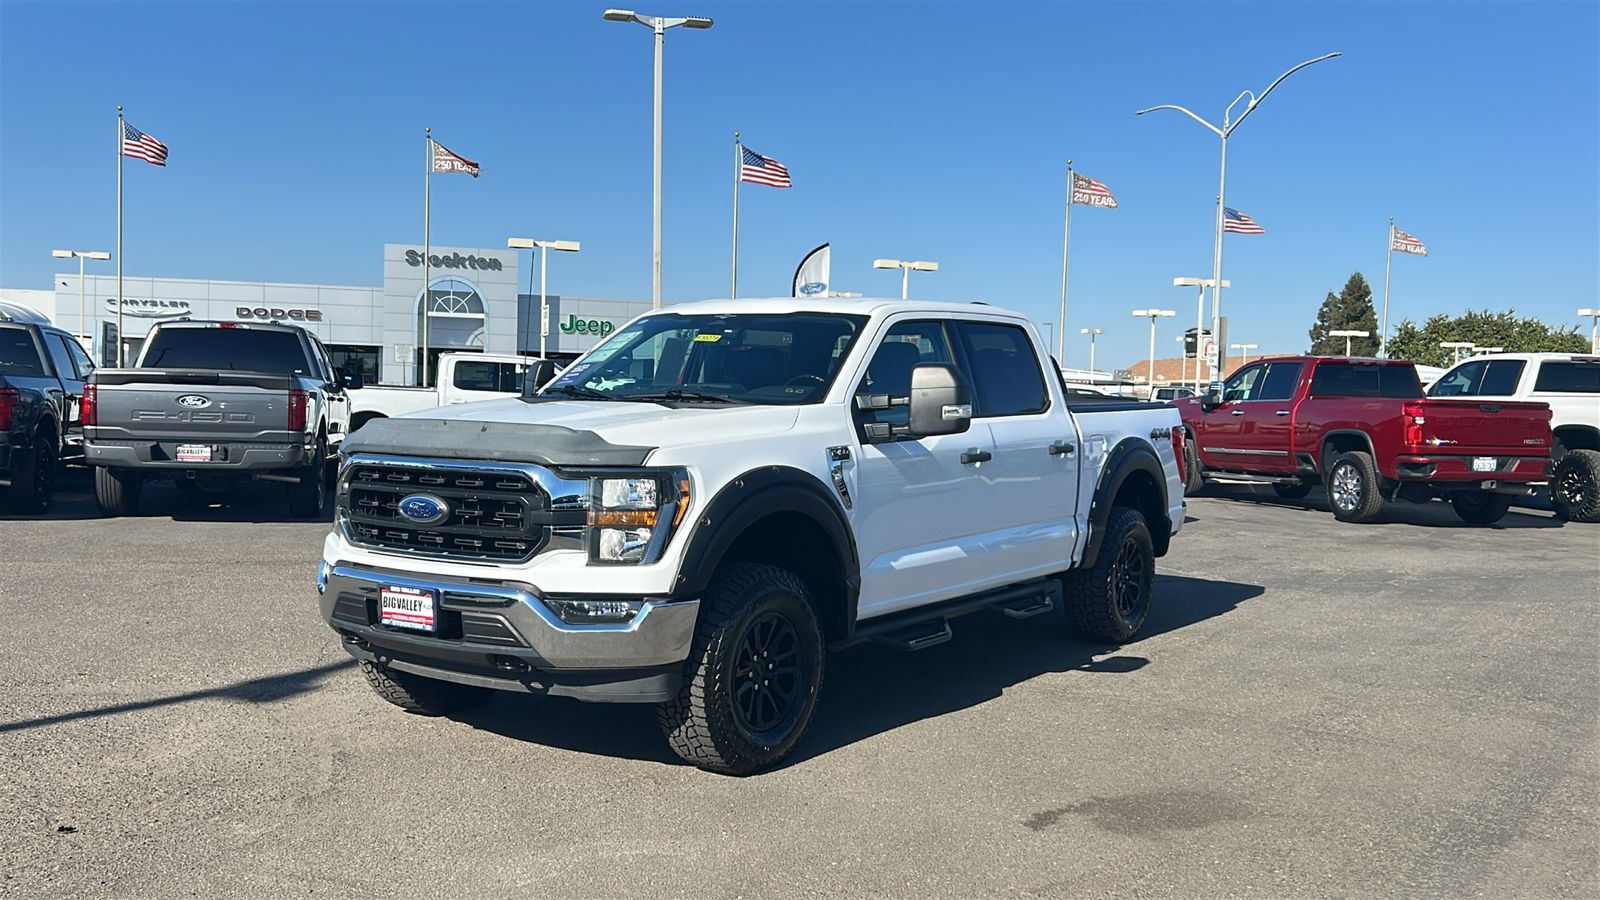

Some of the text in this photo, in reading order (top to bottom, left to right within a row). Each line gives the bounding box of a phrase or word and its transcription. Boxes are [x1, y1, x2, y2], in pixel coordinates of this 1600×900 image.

[435, 160, 452, 170] 250
[1074, 192, 1089, 203] 250
[405, 249, 503, 272] Stockton
[106, 298, 190, 309] CHRYSLER
[236, 307, 322, 321] DODGE
[560, 314, 614, 338] Jeep
[131, 409, 255, 423] F-150
[383, 596, 423, 612] BIGVALLEY
